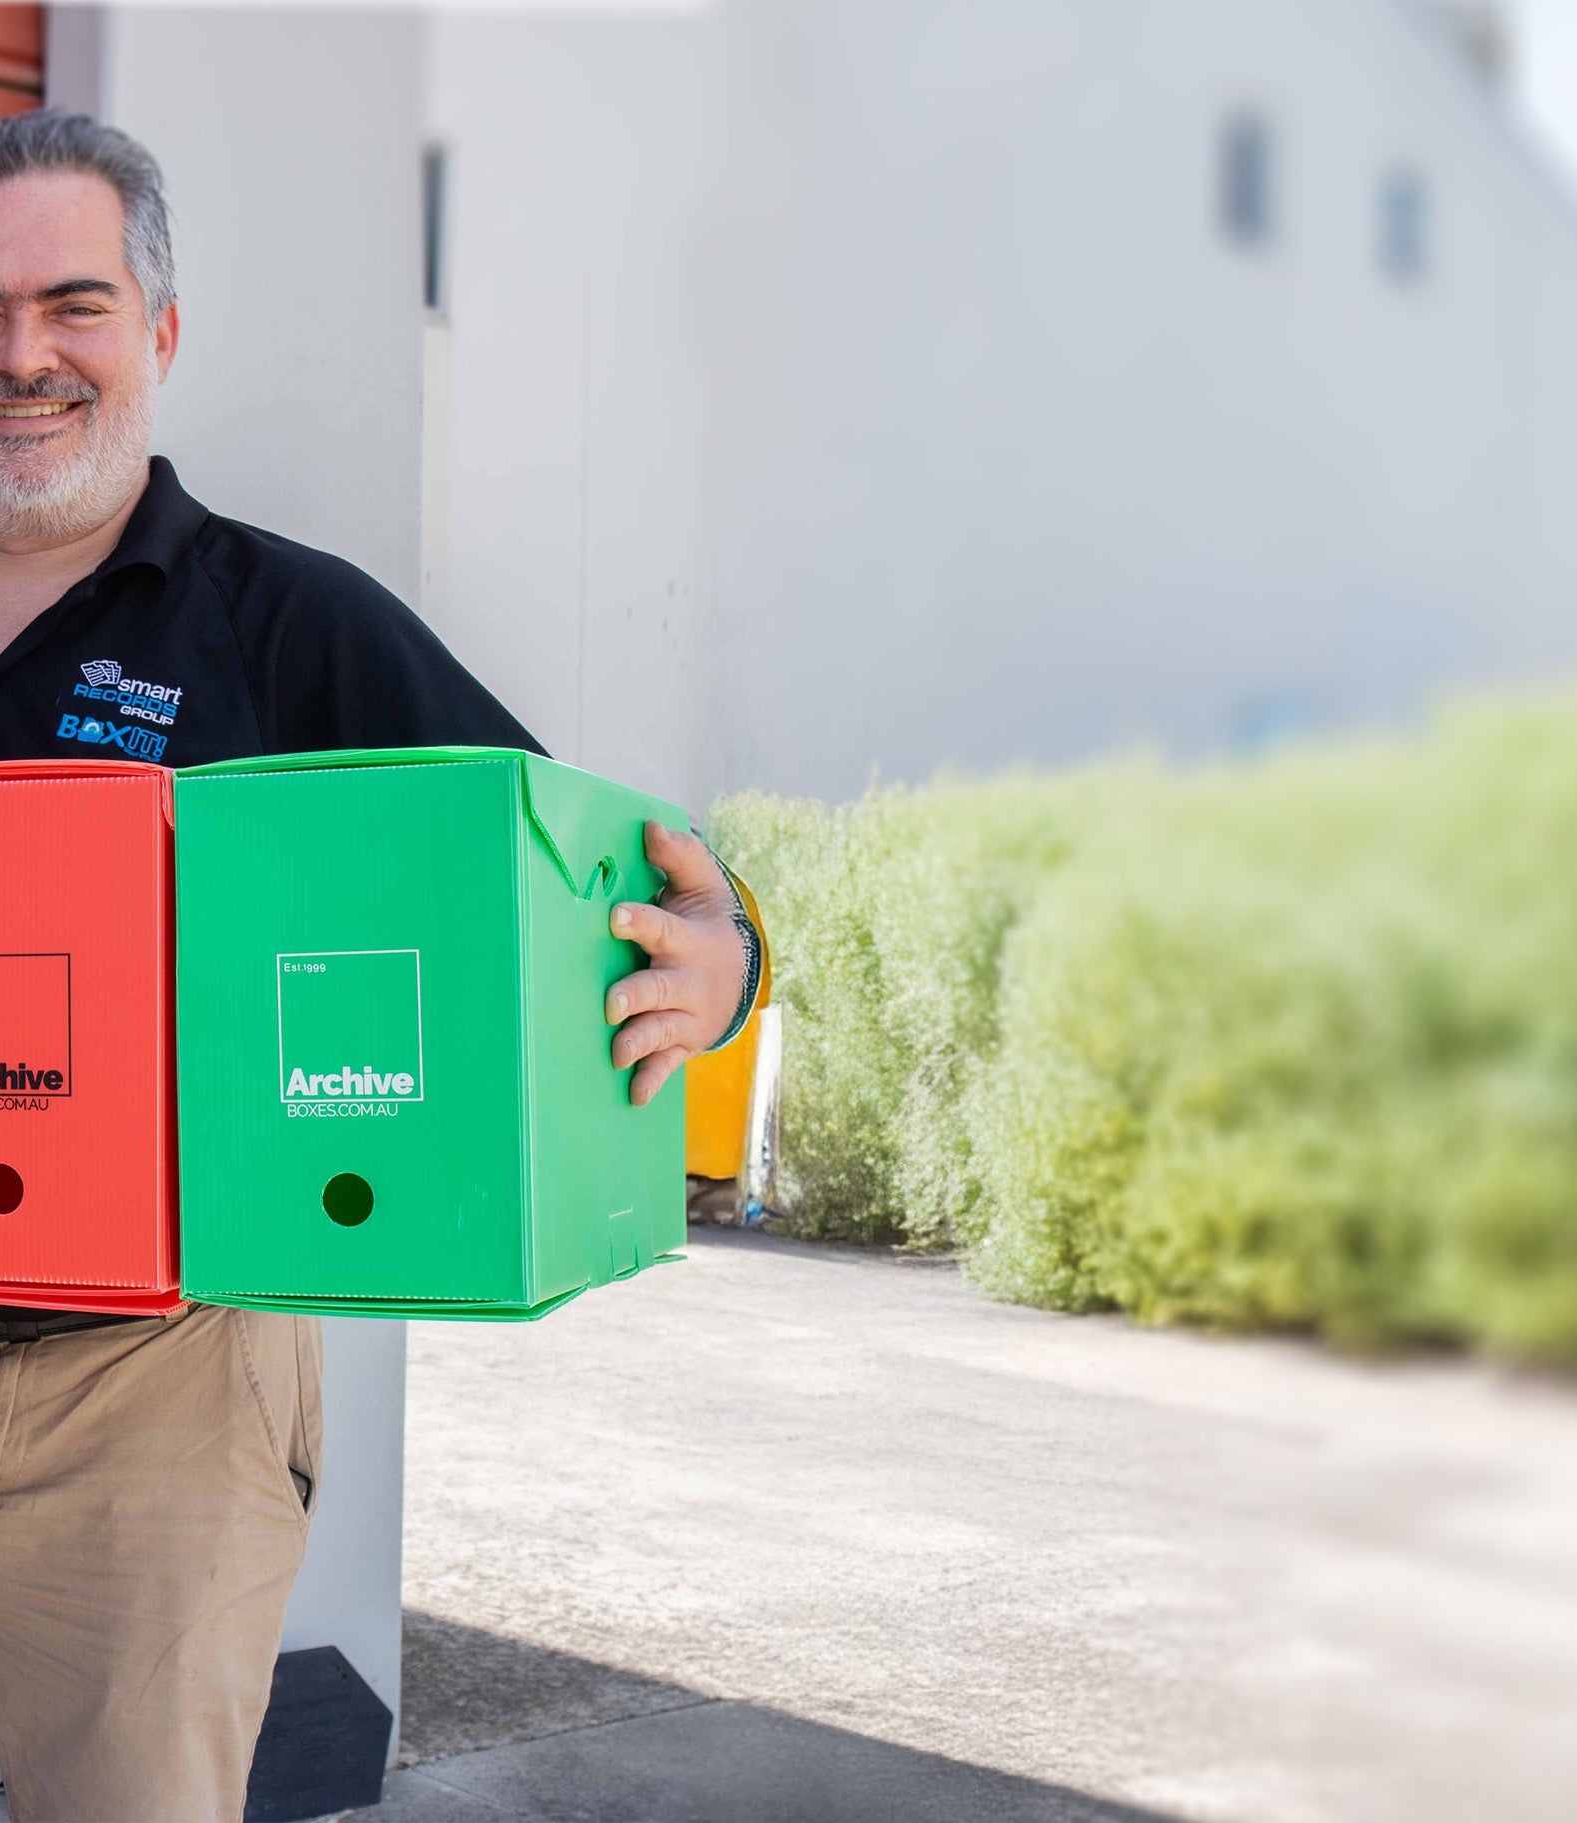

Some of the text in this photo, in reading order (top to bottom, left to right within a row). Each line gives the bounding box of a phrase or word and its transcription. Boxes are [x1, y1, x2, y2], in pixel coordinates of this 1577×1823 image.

[73, 683, 178, 718] RECORDS
[117, 678, 183, 705] smart
[119, 705, 175, 726] GROUP
[285, 1065, 415, 1097] Archive
[287, 1102, 399, 1118] BOXES.COM.AU
